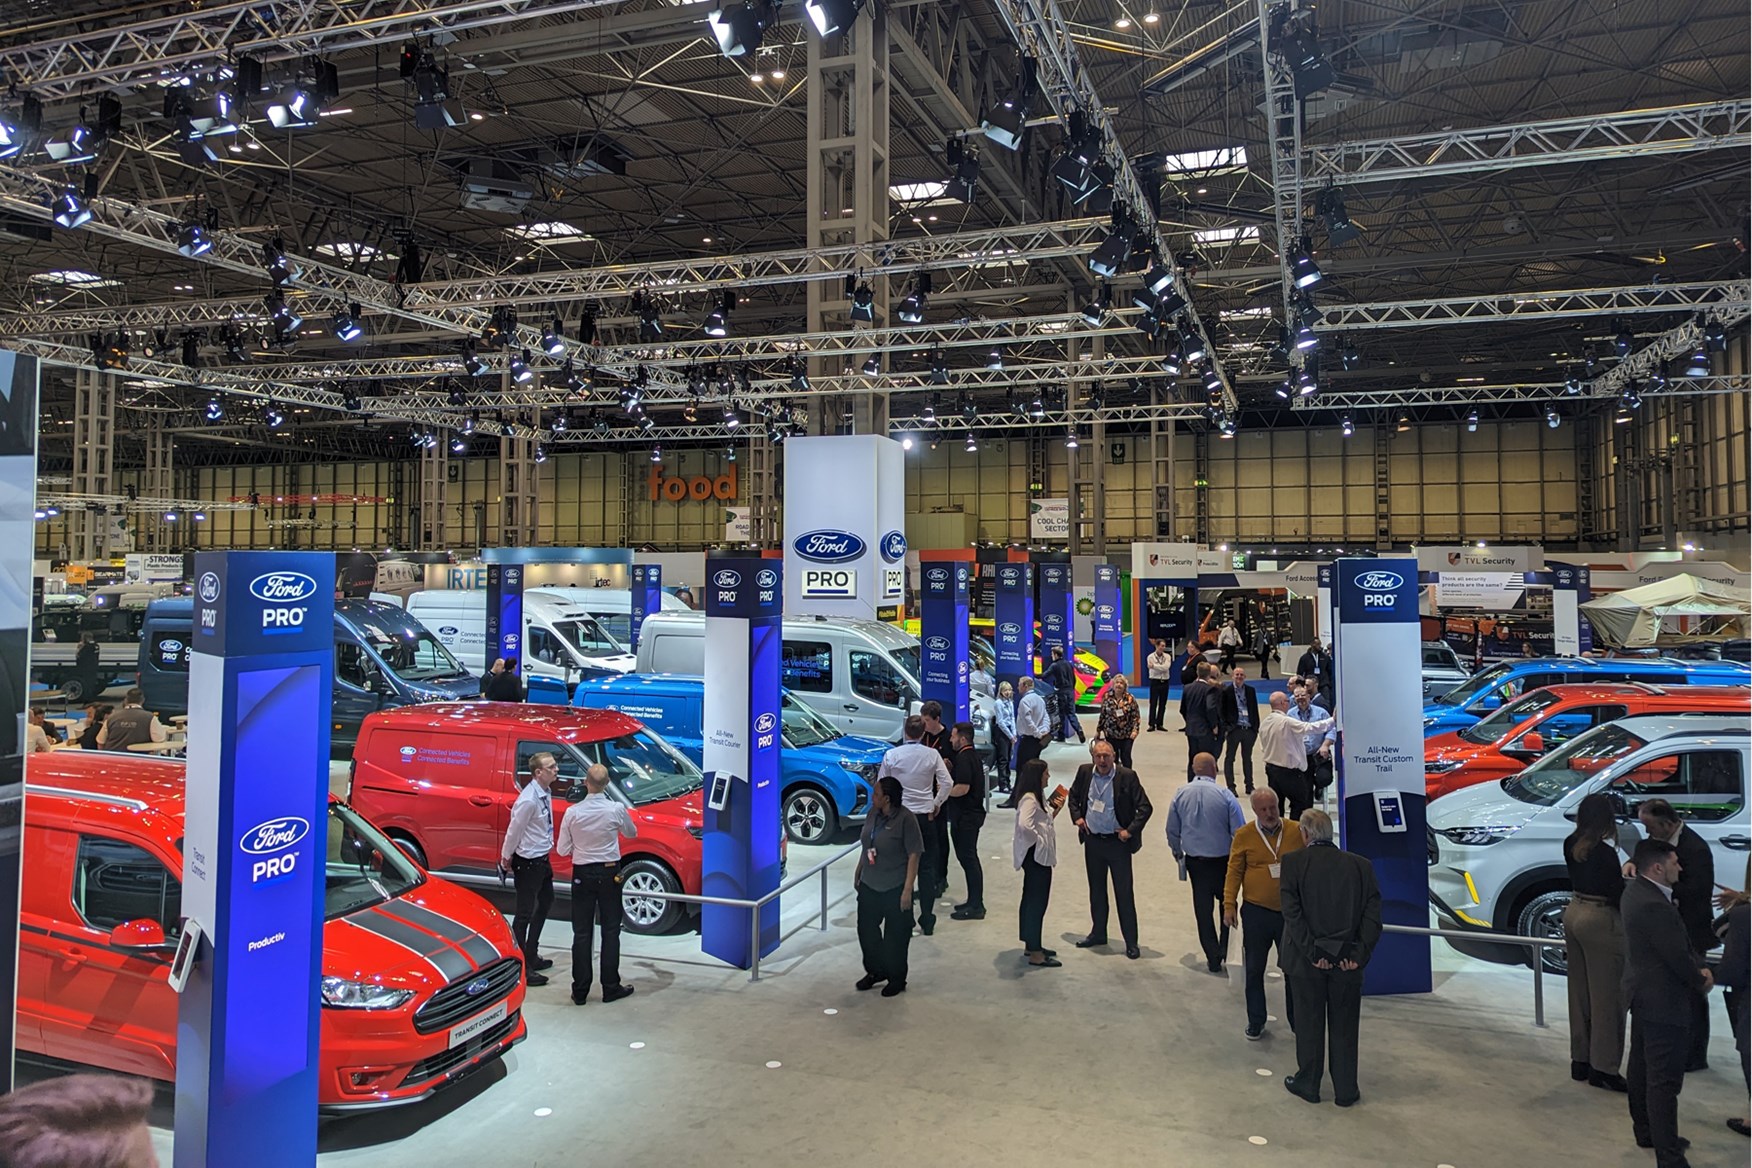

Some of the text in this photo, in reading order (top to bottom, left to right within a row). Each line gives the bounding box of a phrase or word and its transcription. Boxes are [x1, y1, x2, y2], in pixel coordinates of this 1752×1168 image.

[647, 462, 737, 502] food
[805, 534, 849, 554] Ford
[1171, 558, 1193, 567] Security
[1464, 557, 1516, 566] TVL Security
[806, 571, 849, 587] PRO
[888, 571, 902, 587] PRO
[1512, 631, 1528, 639] TVL
[1528, 631, 1555, 640] Securit
[927, 671, 949, 679] Connecting
[715, 729, 734, 739] All-New
[709, 736, 742, 749] Transit Courier
[418, 747, 471, 758] Connected Vehicles
[1367, 745, 1400, 754] All-New
[417, 755, 446, 763] Connected
[446, 757, 470, 766] Benefits
[1353, 755, 1414, 764] Transit Custom
[1375, 764, 1393, 773] Trail
[248, 932, 286, 952] Productiv
[454, 1008, 504, 1040] TRANSIT CONNECT
